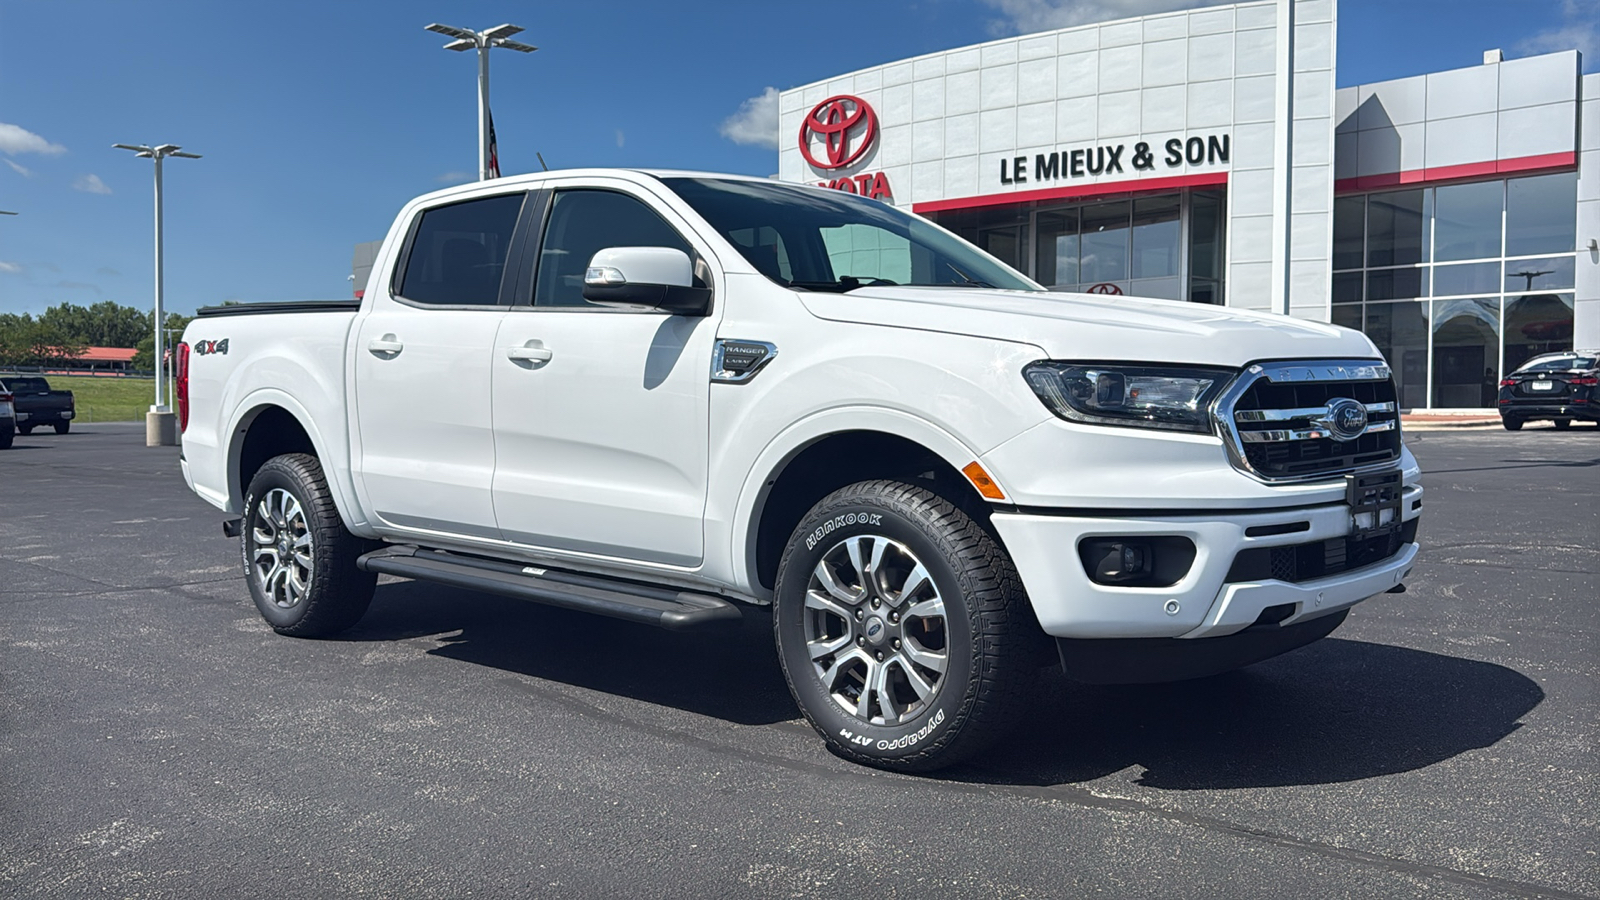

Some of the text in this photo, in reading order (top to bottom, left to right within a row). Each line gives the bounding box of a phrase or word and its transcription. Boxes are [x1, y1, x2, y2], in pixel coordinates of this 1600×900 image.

[1000, 134, 1230, 185] LE MIEUX & SON
[809, 171, 892, 200] OTA
[726, 346, 765, 355] RANGER
[1343, 407, 1364, 428] Ford
